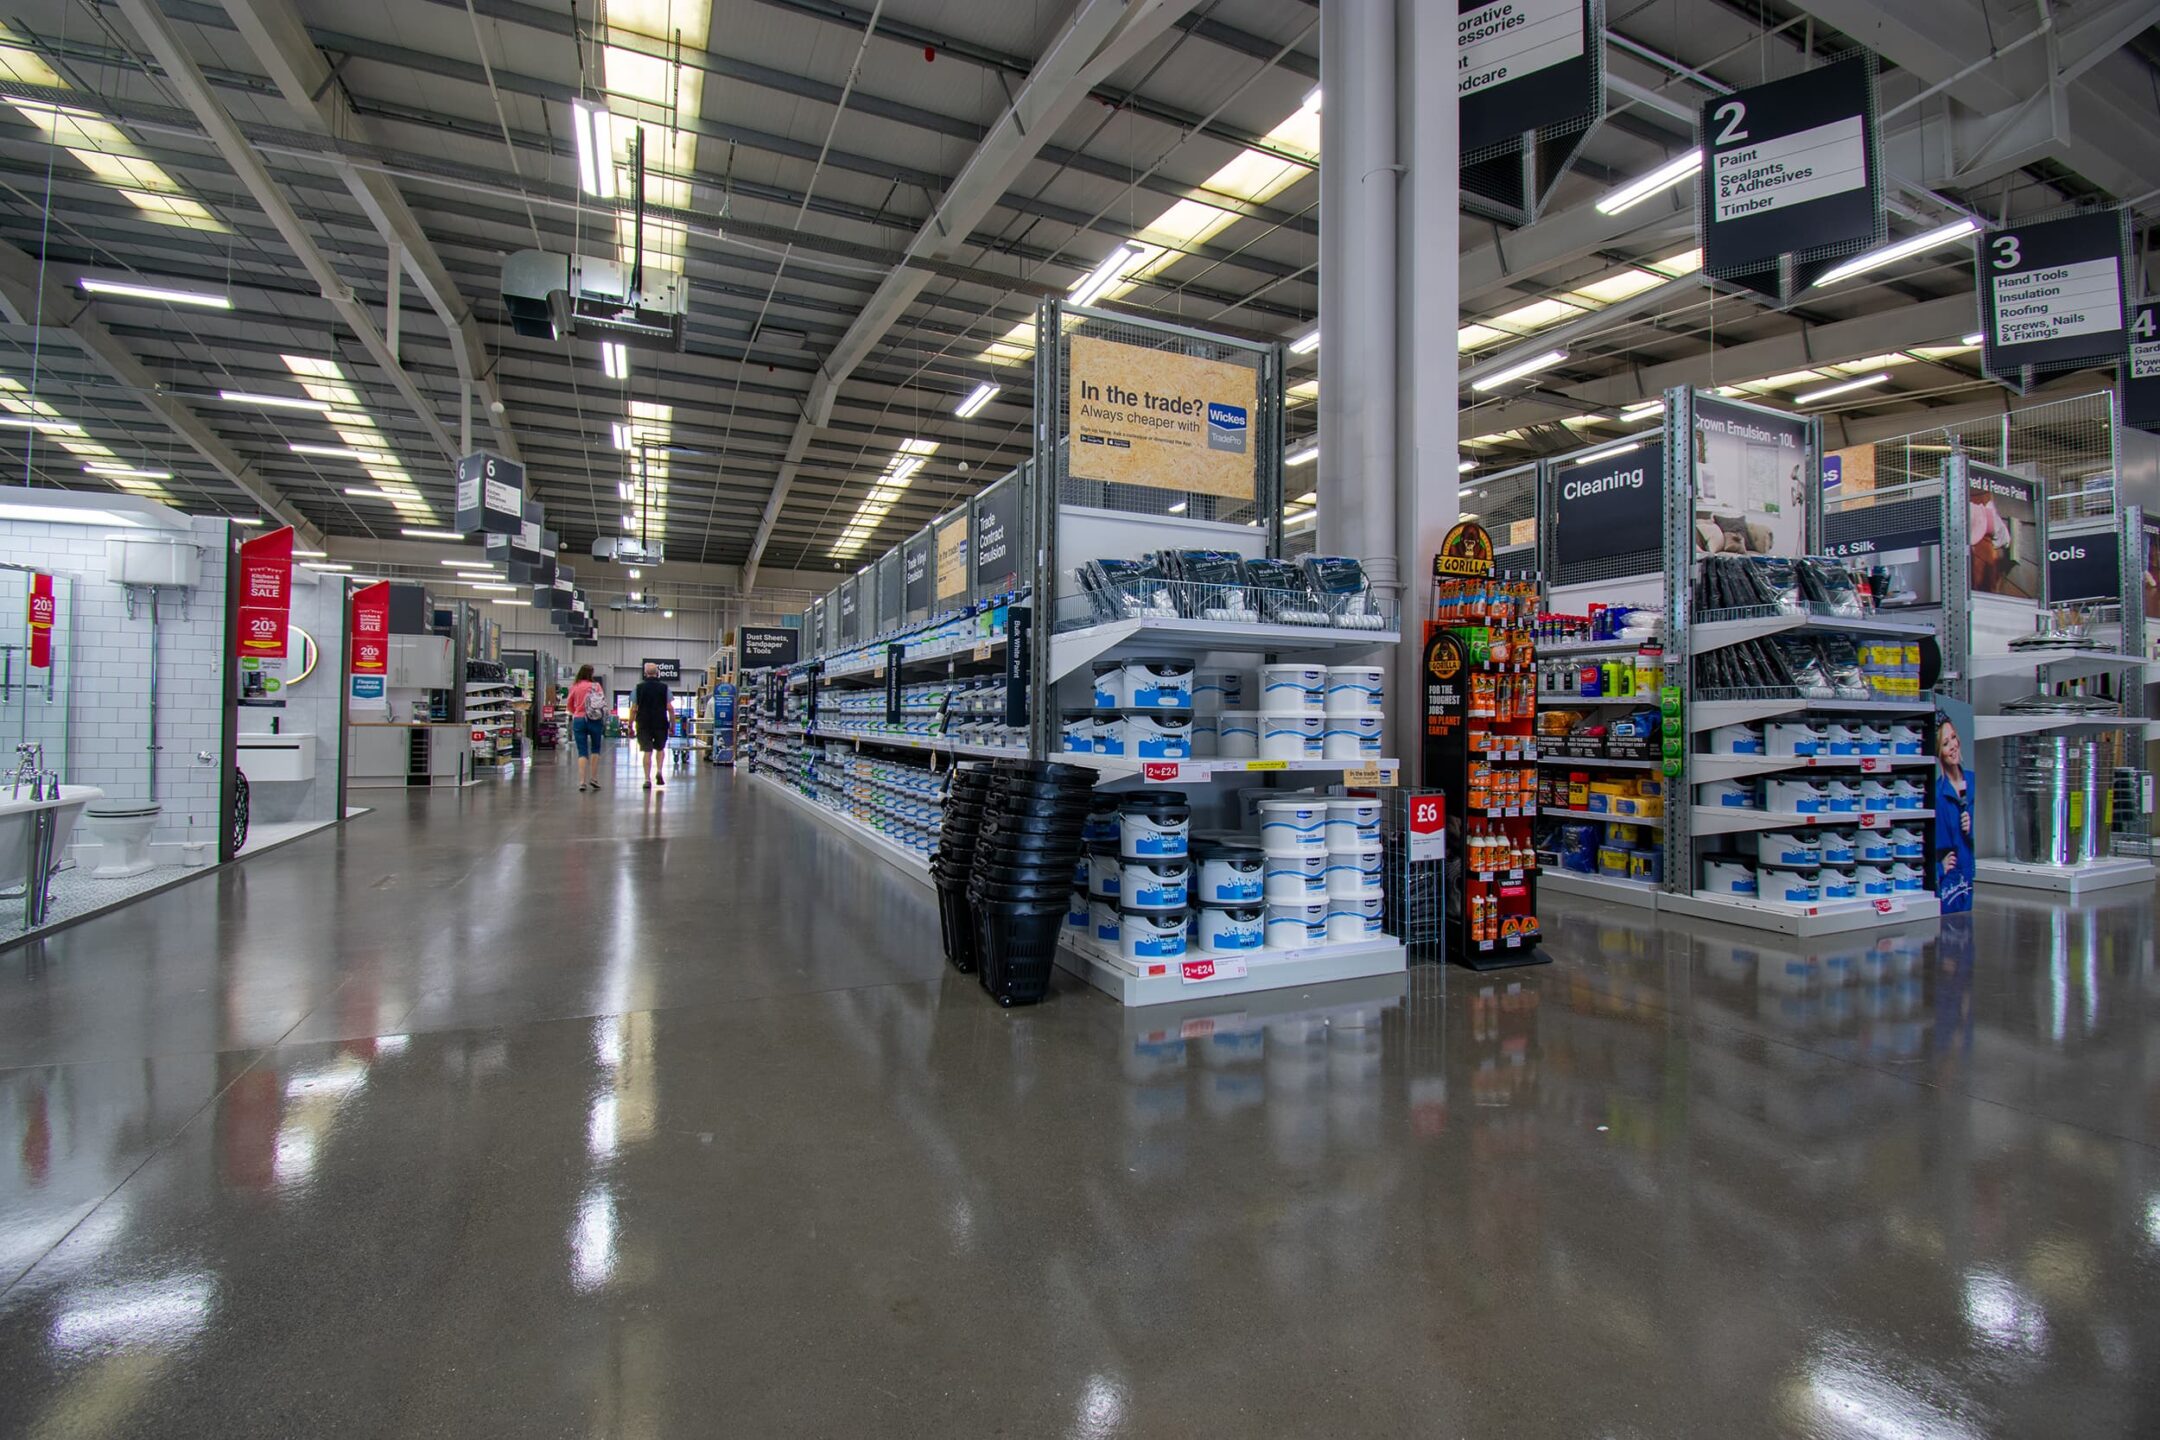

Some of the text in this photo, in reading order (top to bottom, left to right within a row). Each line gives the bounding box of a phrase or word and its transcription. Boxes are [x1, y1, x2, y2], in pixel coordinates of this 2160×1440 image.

[1458, 5, 1512, 32] orative
[1458, 14, 1525, 45] essories
[1713, 101, 1748, 146] 2
[1720, 150, 1757, 167] Paint
[1721, 163, 1784, 186] Sealants
[1721, 167, 1813, 198] & Adhesives
[1721, 197, 1774, 216] Timber
[1992, 236, 2021, 269] 3
[1998, 269, 2069, 288] Hand Tools
[1999, 286, 2060, 303] Insulation
[2000, 304, 2049, 318] Roofing
[2001, 313, 2085, 333] Screws, Nails
[2131, 309, 2156, 337] 4
[2002, 327, 2059, 342] & Fixings
[2136, 367, 2144, 375] &
[1081, 380, 1203, 417] In the trade?
[1080, 404, 1200, 433] Always cheaper with
[1210, 409, 1246, 425] Wickes
[1211, 433, 1242, 445] TradePro
[1727, 420, 1771, 443] Emulsion
[1779, 432, 1796, 448] 10L
[459, 462, 466, 480] 6
[486, 460, 496, 478] 6
[1564, 468, 1644, 500] Cleaning
[1982, 478, 1989, 491] &
[1989, 480, 2010, 496] Fence
[2011, 485, 2027, 501] Paint
[979, 512, 996, 531] Trade
[979, 525, 1004, 548] Contract
[979, 544, 1007, 567] Emulsion
[1838, 544, 1848, 555] &
[1850, 540, 1875, 553] Silk
[2048, 545, 2086, 562] ools
[907, 550, 927, 570] Trade Vinyl
[1444, 559, 1487, 573] GORILLA
[907, 568, 924, 585] Emulsion
[250, 588, 280, 598] SALE
[360, 624, 381, 632] SALE
[1013, 620, 1021, 637] Bulk
[746, 633, 789, 643] Dust Sheets,
[746, 640, 783, 649] Sandpaper
[1432, 661, 1458, 670] GORILLA
[1429, 685, 1453, 695] FOR THE
[1428, 695, 1461, 705] TOUGHEST
[1428, 705, 1444, 715] JOBS
[1428, 715, 1461, 726] ON PLANET
[1428, 725, 1449, 735] EARTH
[1148, 767, 1154, 776] 2
[1160, 767, 1177, 776] £24
[1417, 803, 1437, 823] £6
[1184, 967, 1191, 977] 2
[1197, 964, 1214, 975] £24
